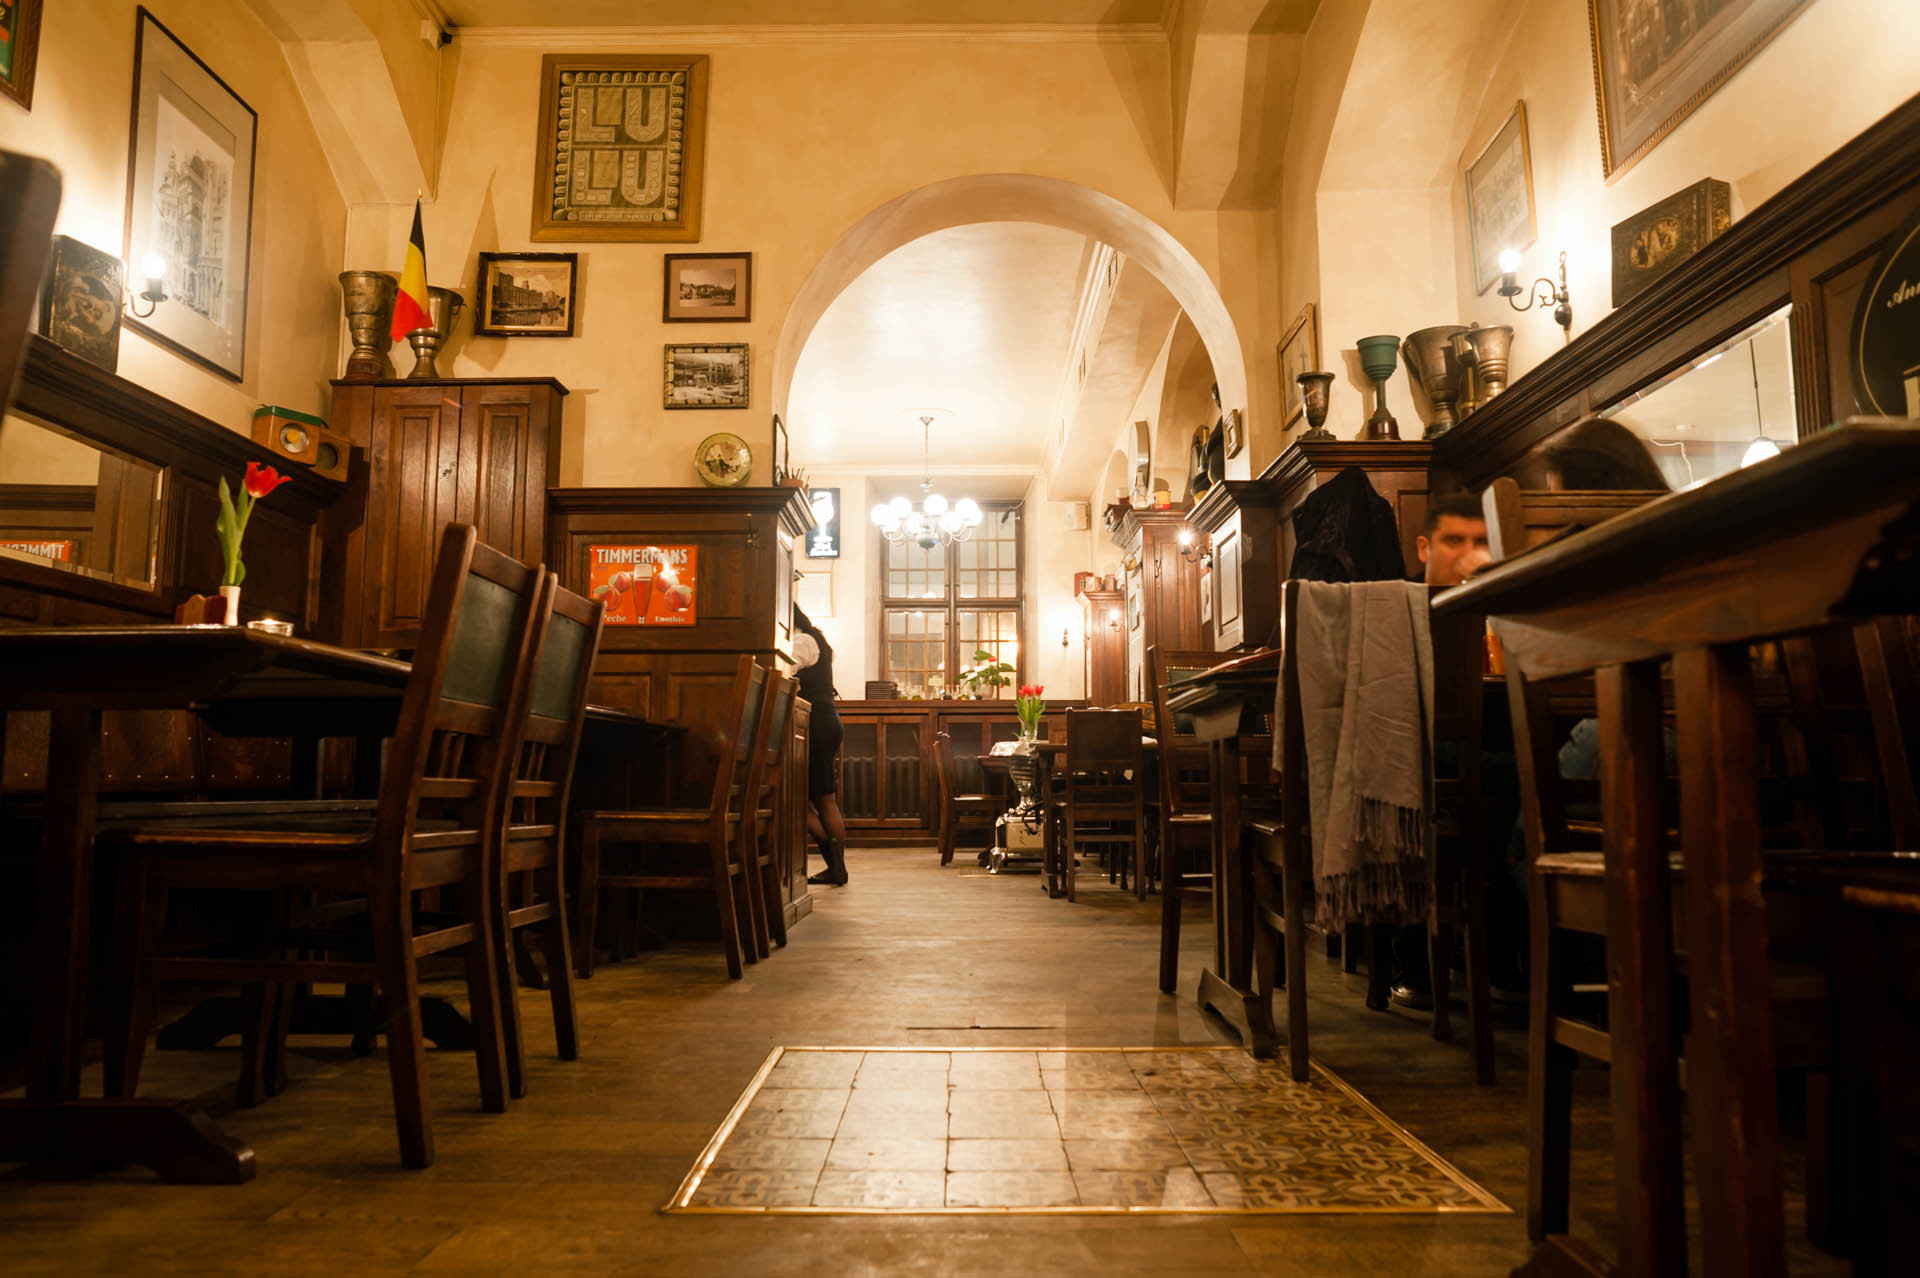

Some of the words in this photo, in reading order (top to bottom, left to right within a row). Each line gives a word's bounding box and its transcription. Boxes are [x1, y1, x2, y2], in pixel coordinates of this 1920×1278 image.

[575, 87, 666, 143] LU
[571, 150, 664, 206] LU
[597, 549, 688, 564] TIMMERMANS
